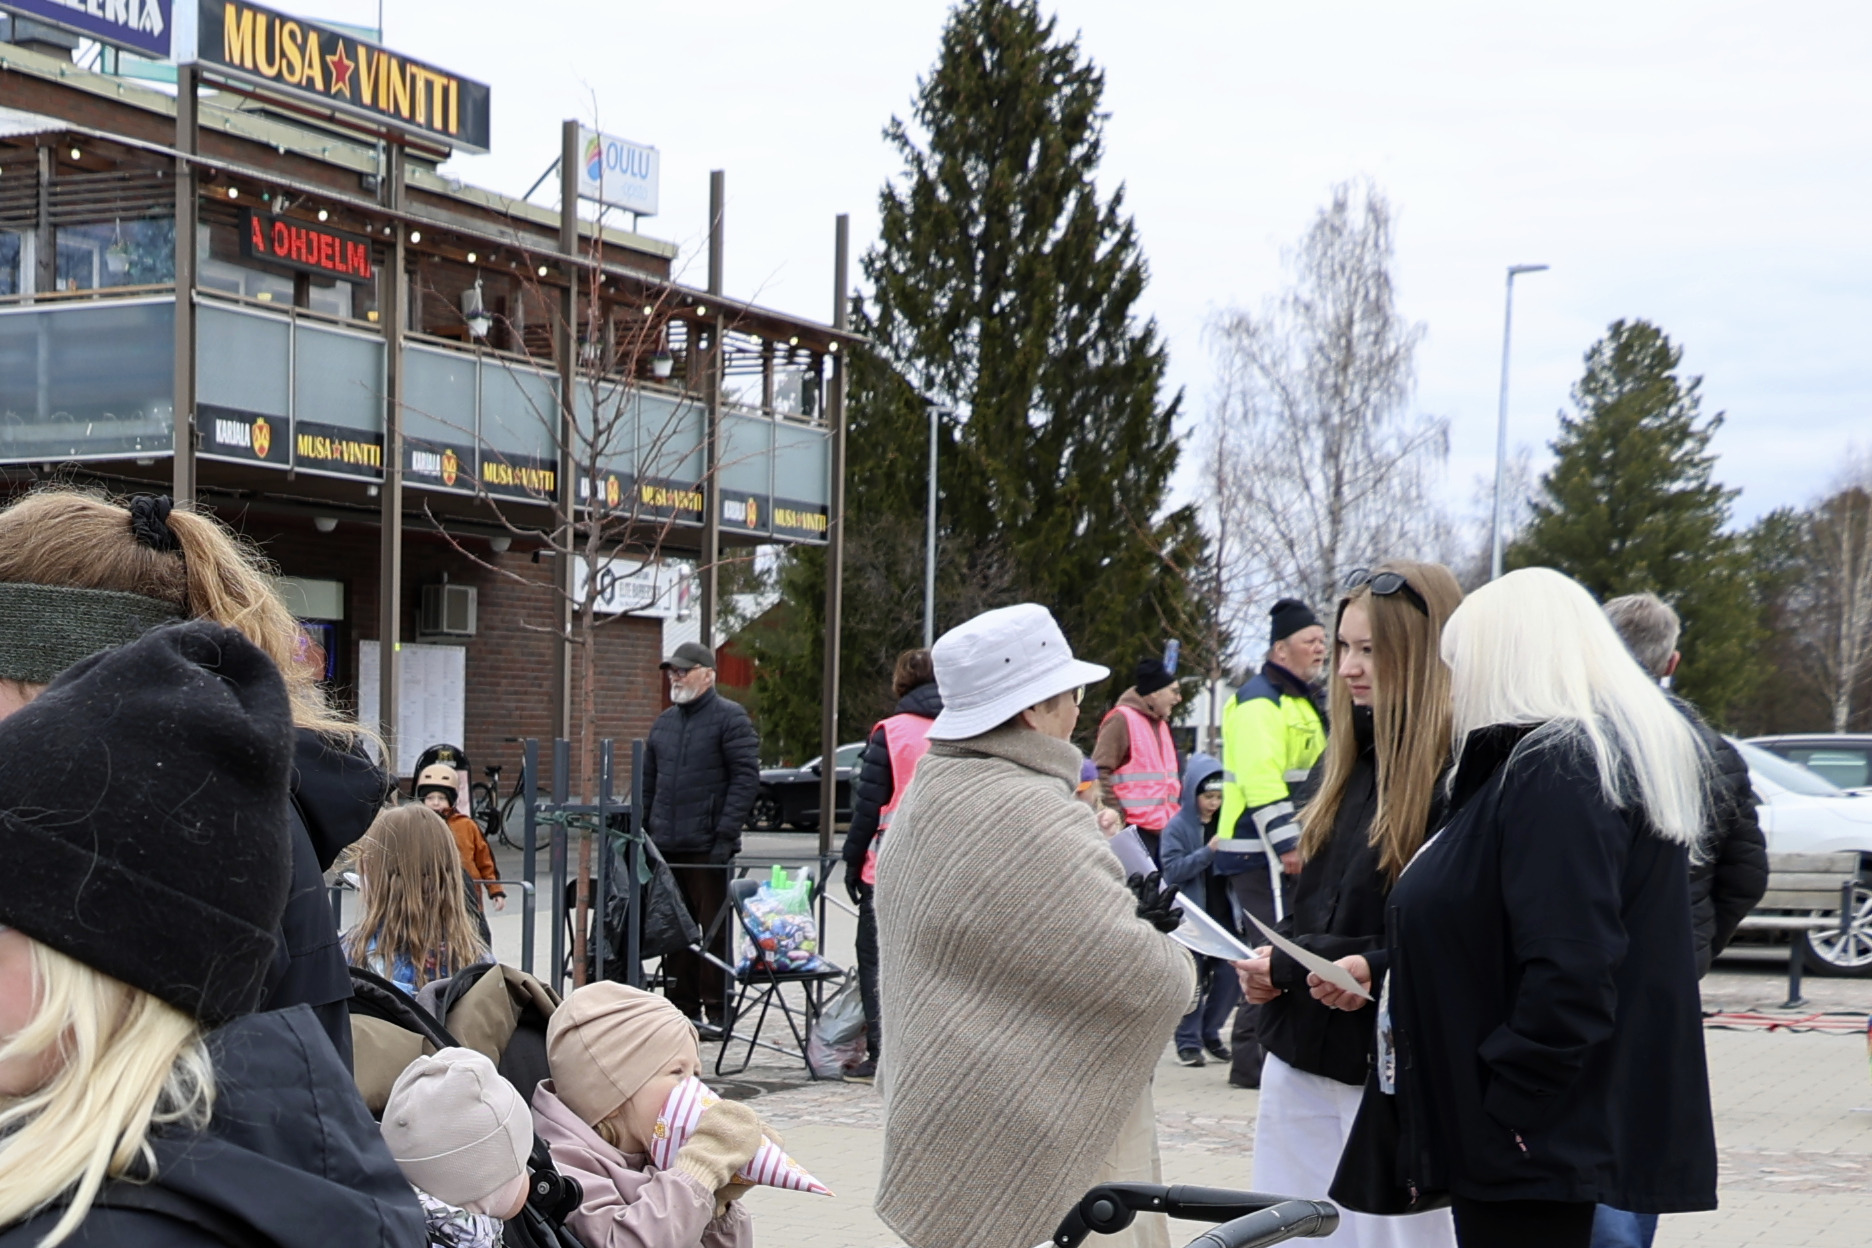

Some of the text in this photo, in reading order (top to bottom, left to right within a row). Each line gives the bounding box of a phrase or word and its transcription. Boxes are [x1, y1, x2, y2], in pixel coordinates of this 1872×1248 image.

[224, 2, 459, 136] MUSA VINTTI
[606, 142, 650, 179] OULU
[272, 221, 372, 278] OHJELM
[215, 418, 251, 447] KARJALA
[297, 434, 381, 466] MUSA VINTTI
[483, 461, 513, 485] MUSA
